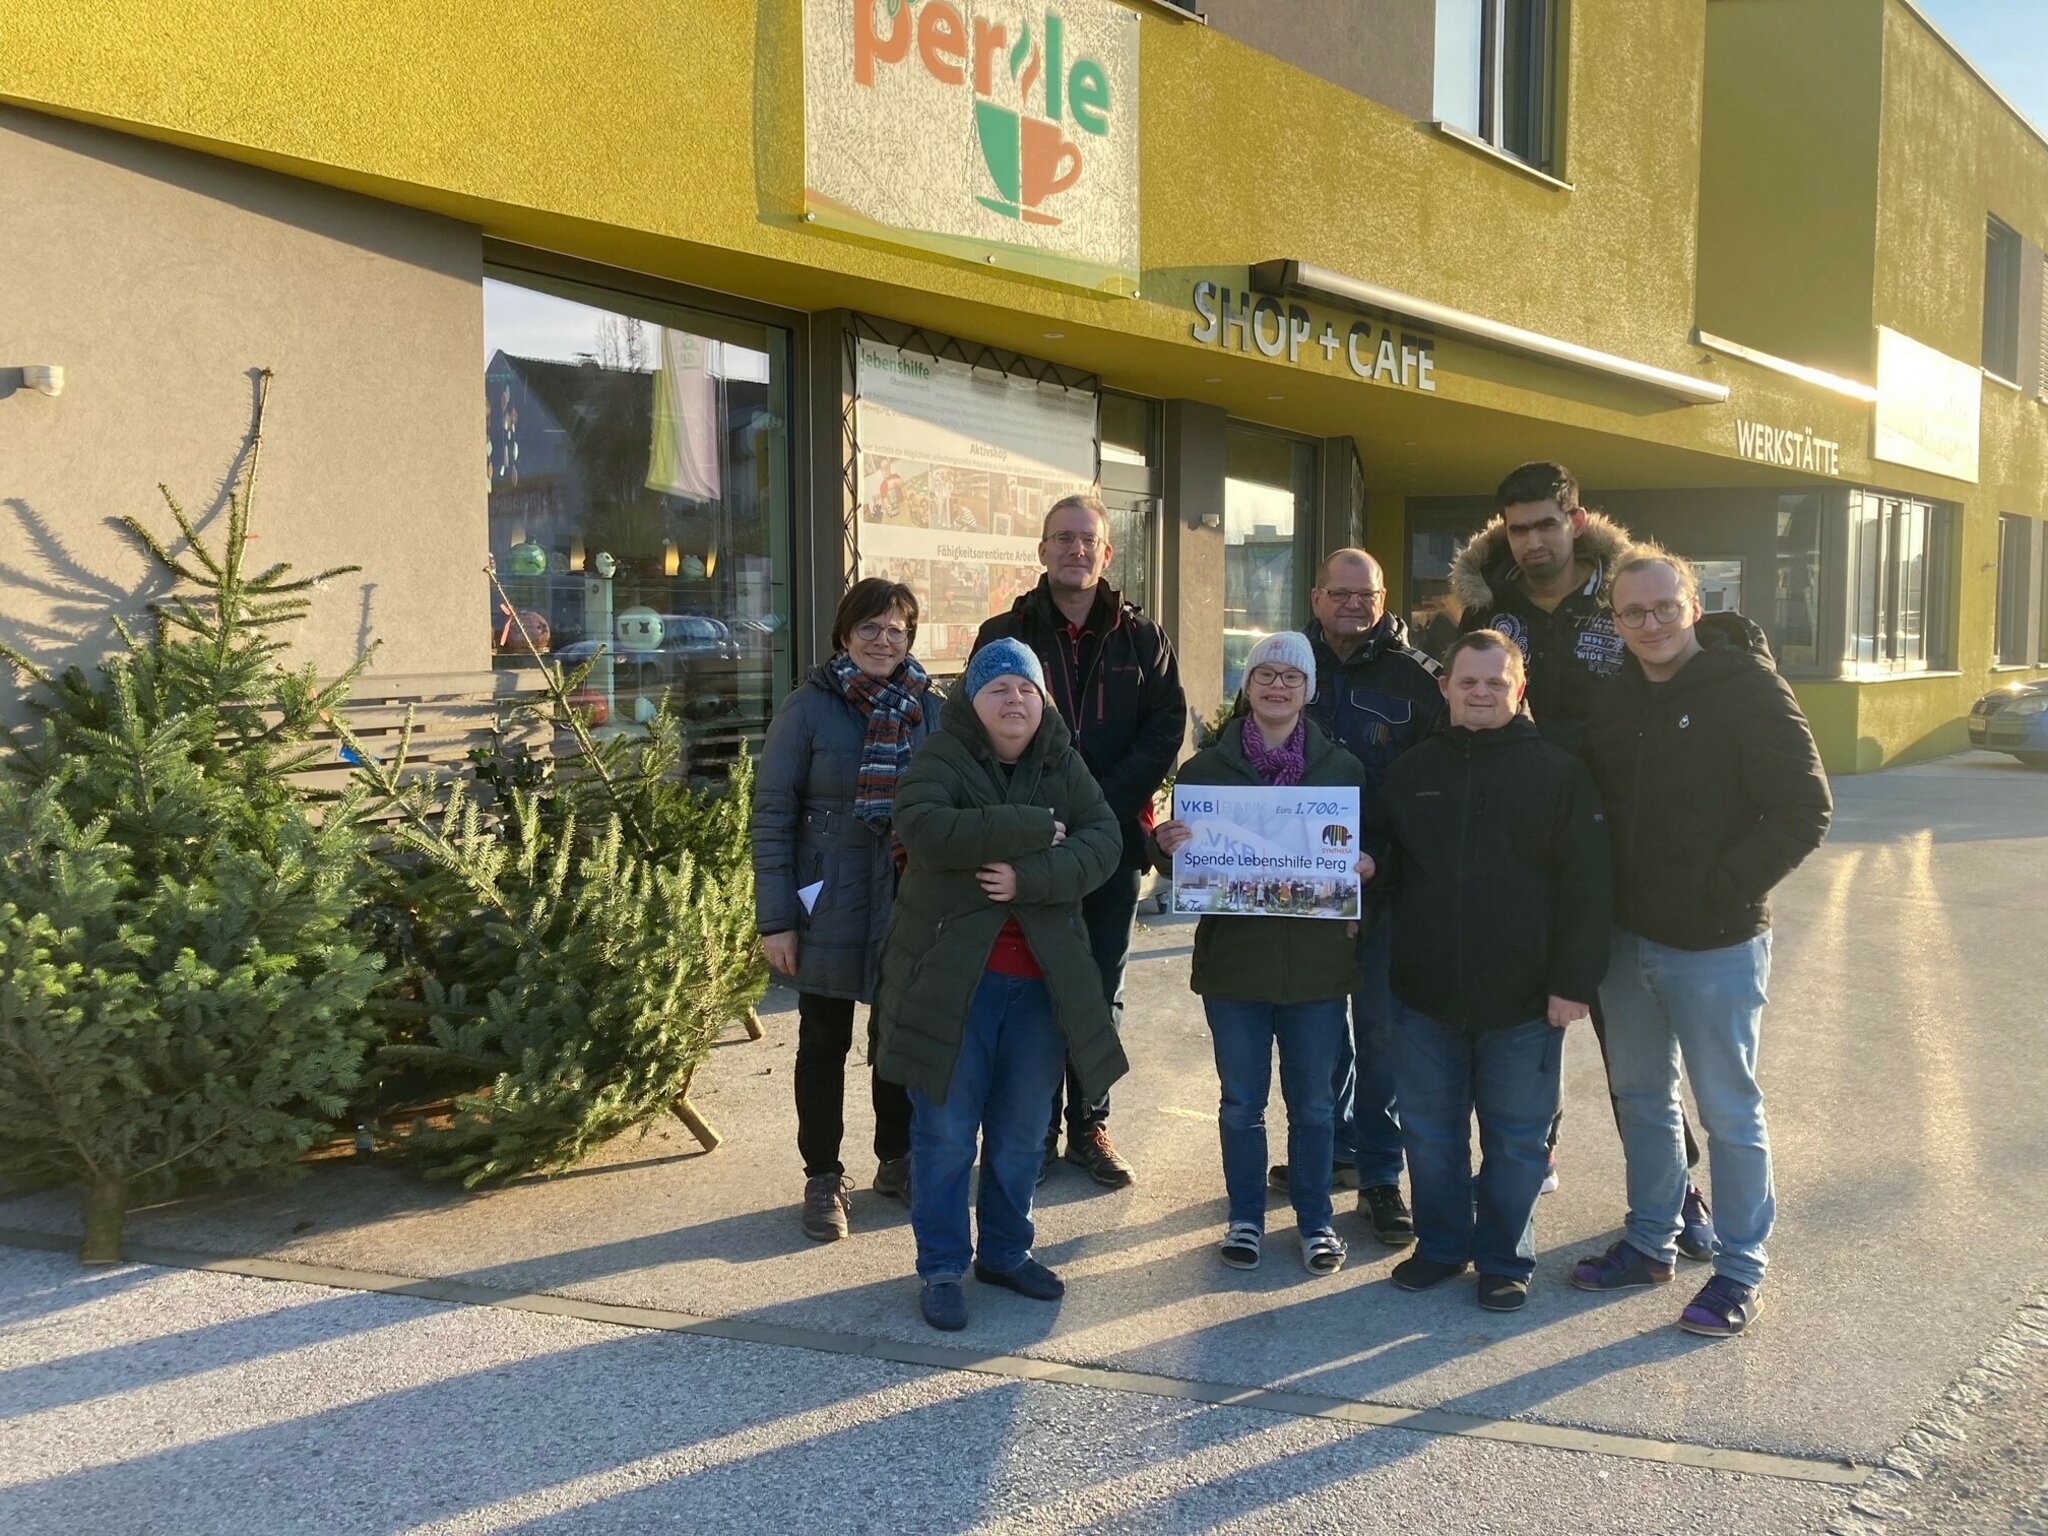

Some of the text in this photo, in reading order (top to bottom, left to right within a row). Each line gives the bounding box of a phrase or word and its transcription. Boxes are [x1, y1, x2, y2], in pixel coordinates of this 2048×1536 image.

[1192, 280, 1311, 362] SHOP
[1319, 321, 1340, 360] +
[861, 348, 930, 379] lebenshilfe
[969, 443, 1008, 462] Aktivshop
[1736, 418, 1840, 475] WERKSTÄTTE
[1577, 651, 1604, 661] WIDE
[1181, 800, 1213, 813] VKB
[1276, 806, 1292, 814] Euro
[1185, 853, 1347, 873] Spende Lebenshilfe Perg
